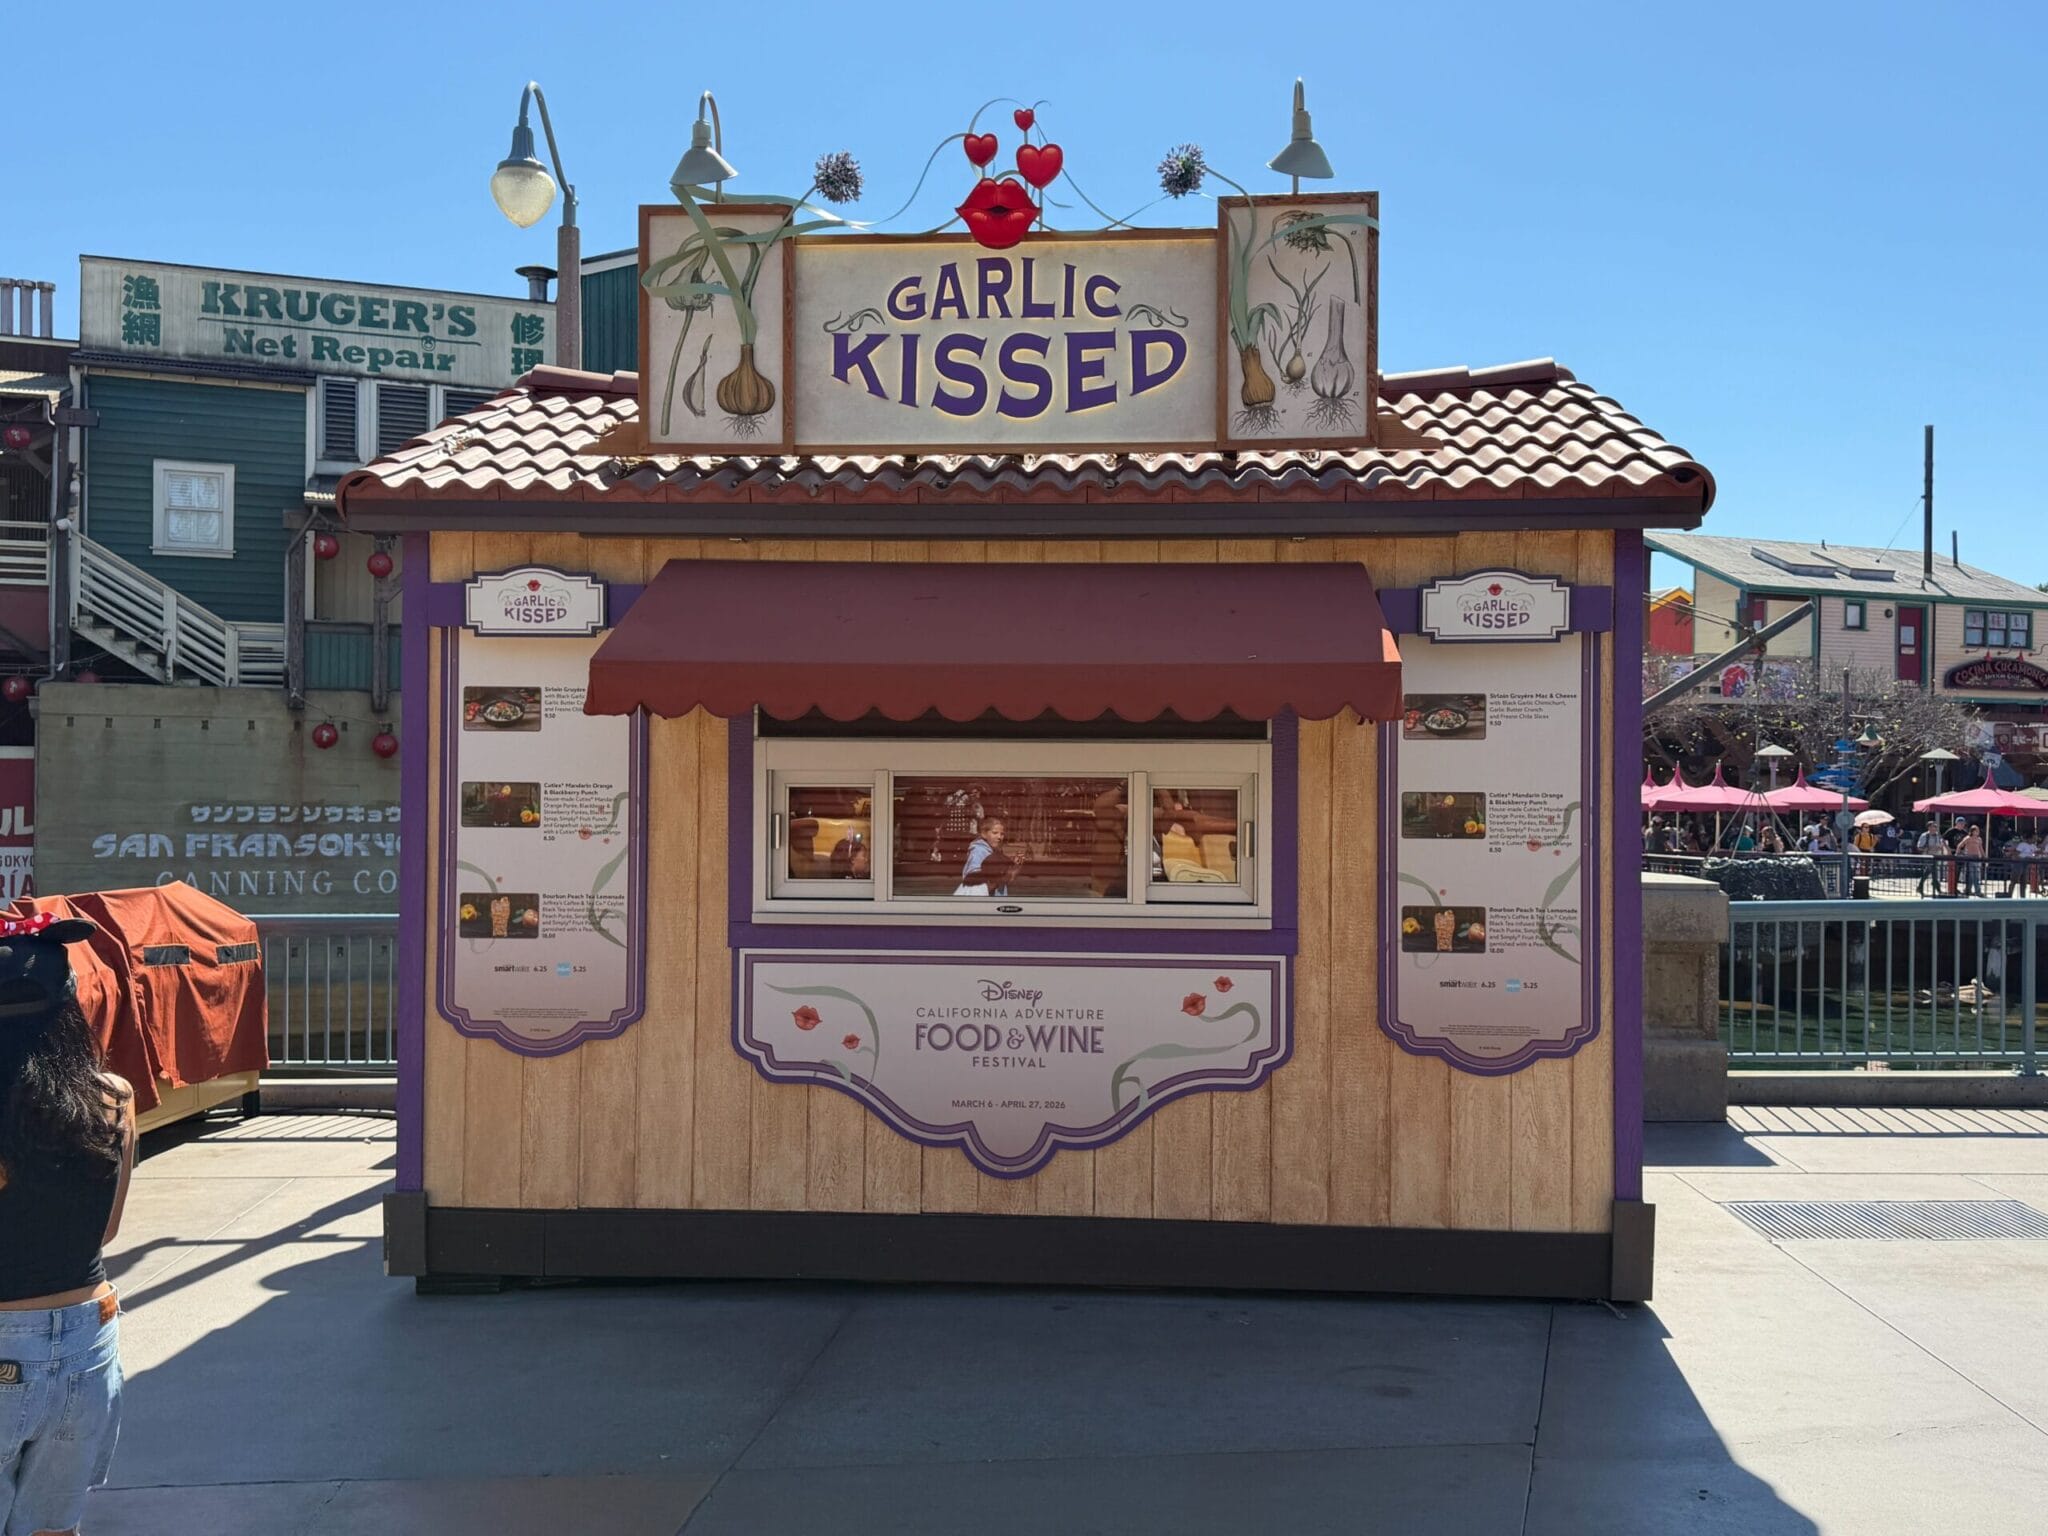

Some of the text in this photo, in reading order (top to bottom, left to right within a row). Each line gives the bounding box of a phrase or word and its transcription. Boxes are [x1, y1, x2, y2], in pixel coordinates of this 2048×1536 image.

[887, 257, 1122, 320] GARLIC
[122, 275, 161, 346] 漁網
[201, 281, 477, 337] KRUGER'S
[223, 327, 456, 372] Net Repair
[831, 327, 1187, 419] KISSED
[514, 595, 556, 607] GARLIC
[1473, 599, 1518, 612] GARLIC
[504, 607, 567, 624] KISSED
[1463, 612, 1531, 629] KISSED
[92, 833, 175, 859] SAN
[916, 1007, 1104, 1020] CALIFORNIA ADVENTURE
[915, 1023, 1104, 1054] FOOD & WINE
[972, 1056, 1046, 1068] FESTIVAL
[952, 1100, 987, 1108] MARCH
[988, 1100, 993, 1108] 6
[1001, 1100, 1027, 1109] APRIL
[1029, 1100, 1042, 1110] 27,
[1043, 1101, 1066, 1109] 2026
